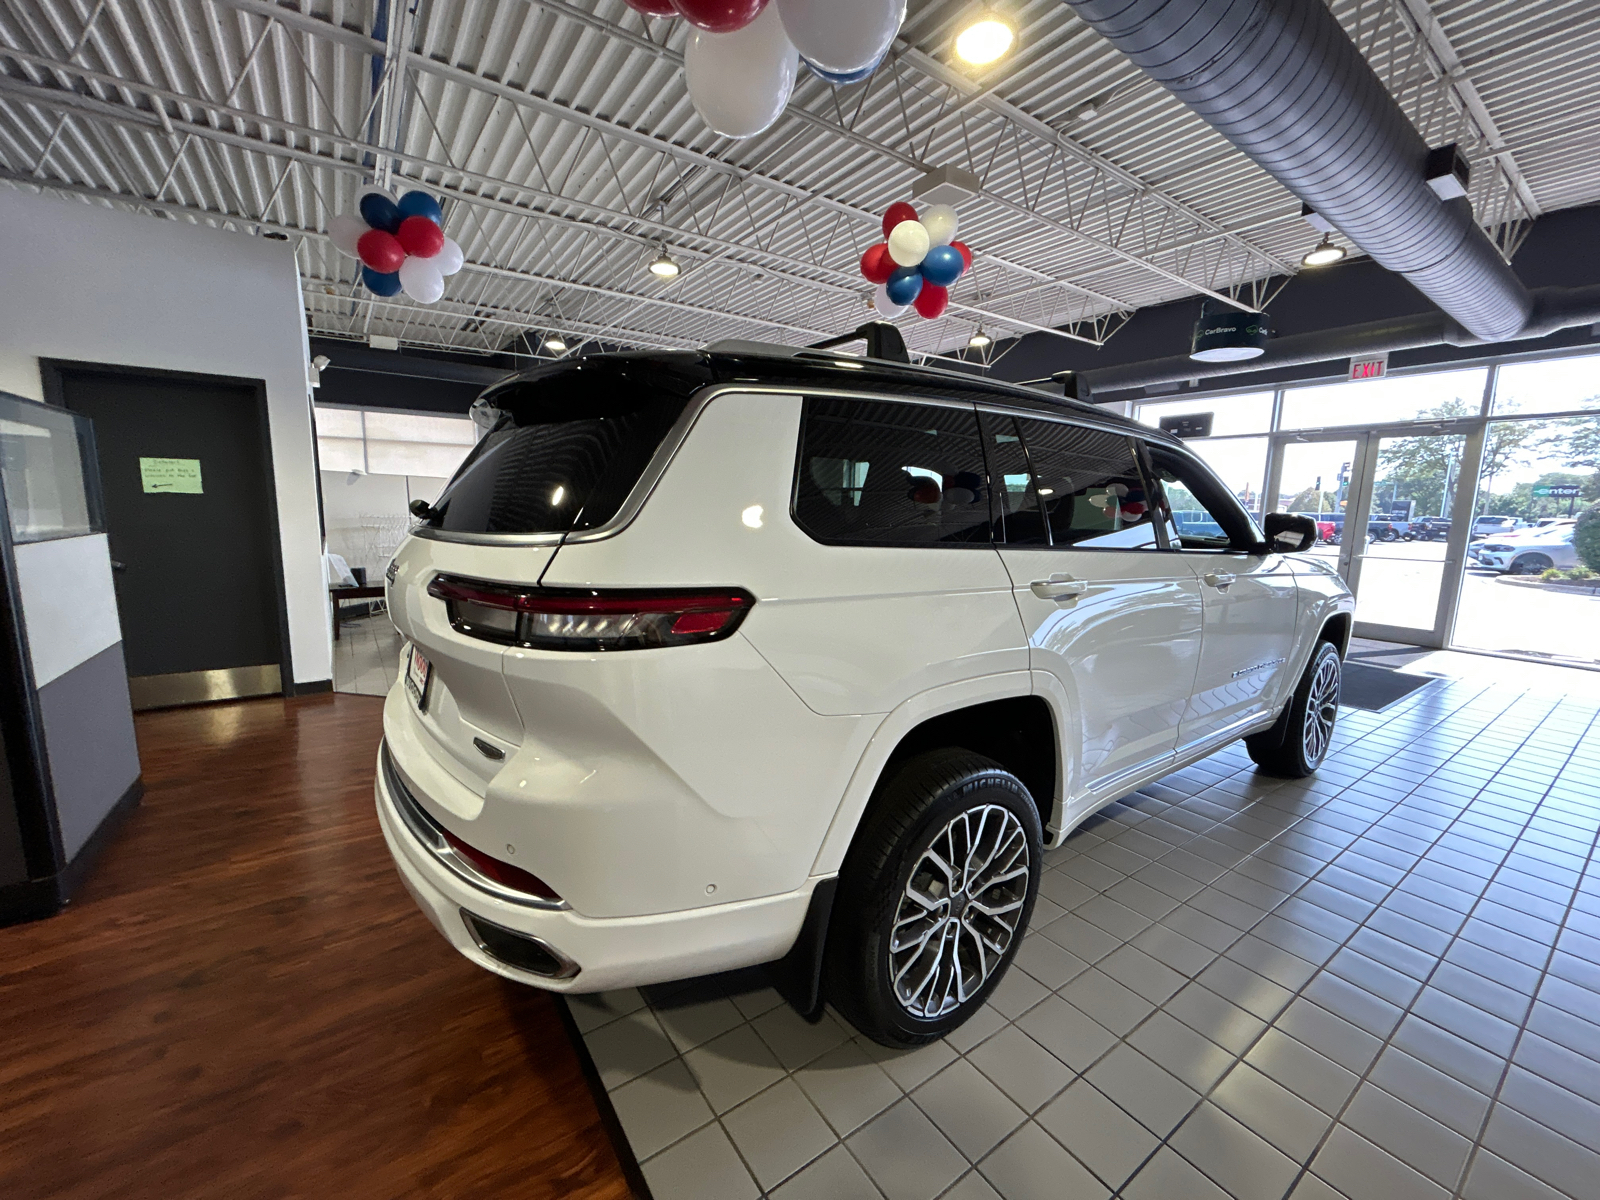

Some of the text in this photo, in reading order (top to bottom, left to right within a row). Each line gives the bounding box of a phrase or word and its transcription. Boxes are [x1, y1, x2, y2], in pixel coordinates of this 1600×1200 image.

[1204, 326, 1237, 336] CarBravo
[1352, 361, 1385, 379] EXIT
[962, 778, 1019, 795] MICHELIN
